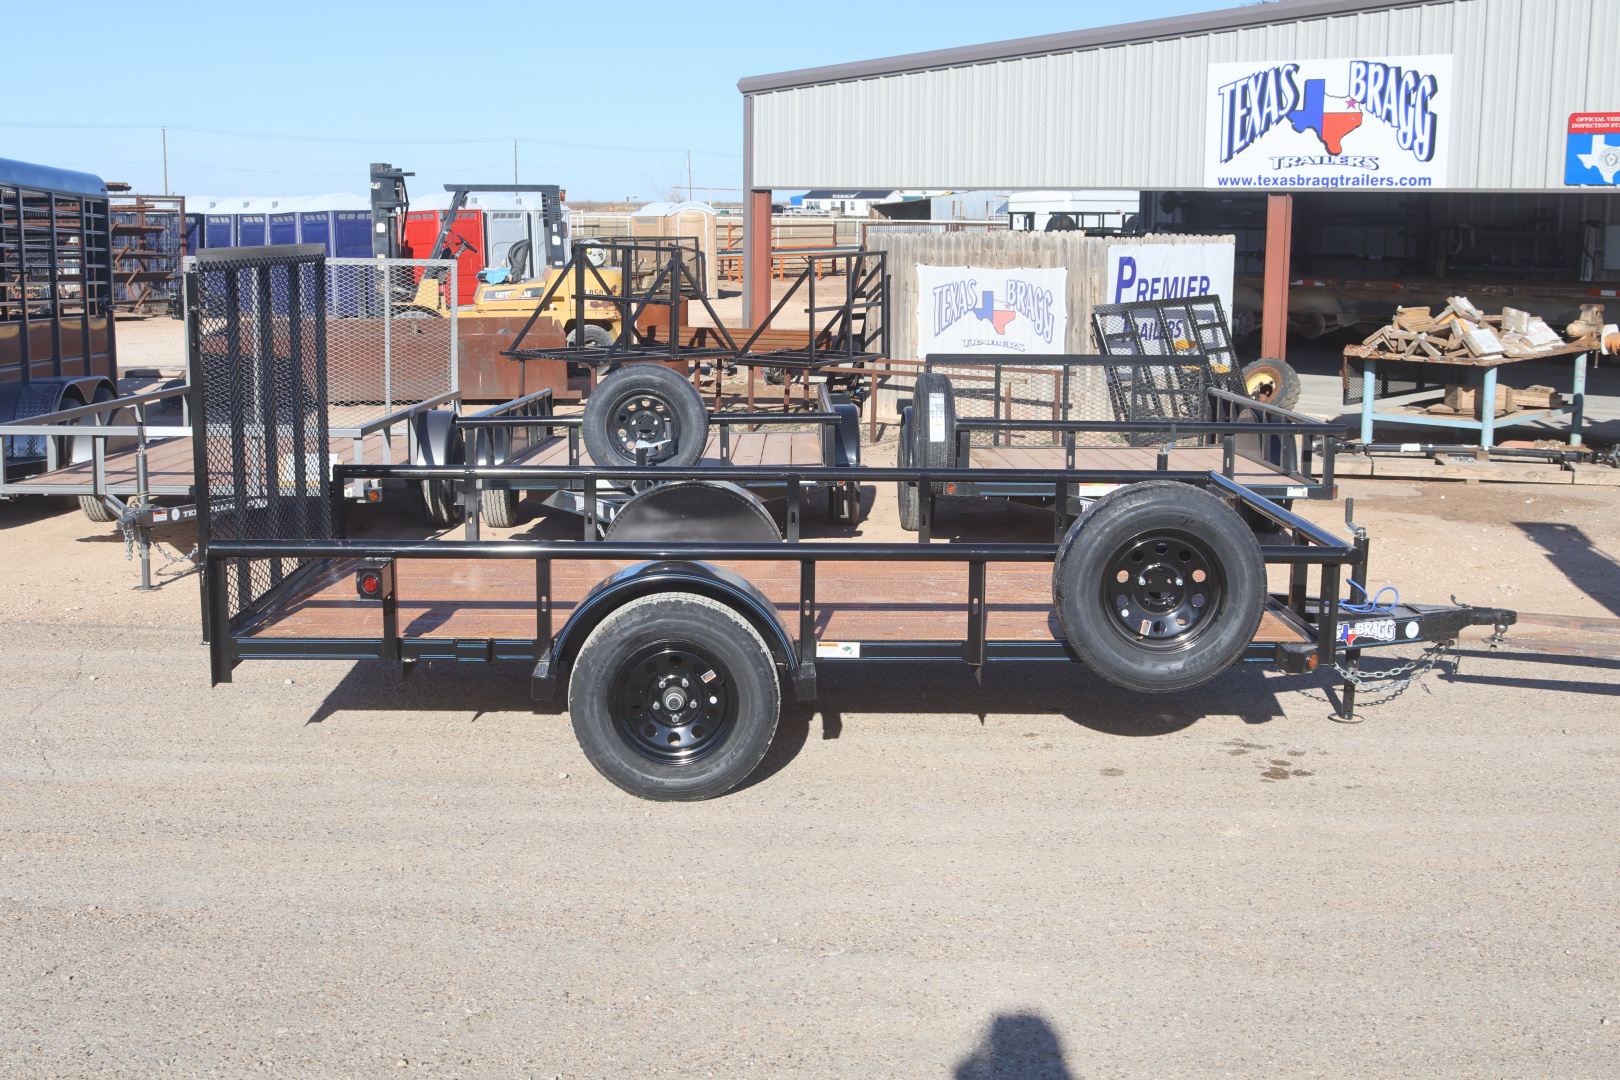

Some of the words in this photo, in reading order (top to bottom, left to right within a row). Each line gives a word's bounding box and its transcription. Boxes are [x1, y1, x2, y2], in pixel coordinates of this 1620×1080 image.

[1218, 63, 1300, 164] TEXAS
[1349, 60, 1438, 162] BRAGG
[1269, 155, 1379, 170] TRAILERS
[1218, 174, 1432, 188] www.texasbraggtrailers.com
[1114, 256, 1210, 305] PREMIER
[933, 279, 978, 337] TEXAS
[1006, 279, 1054, 344] BRAGG
[962, 339, 1025, 352] TRAILERS
[1355, 620, 1396, 641] BRAGG
